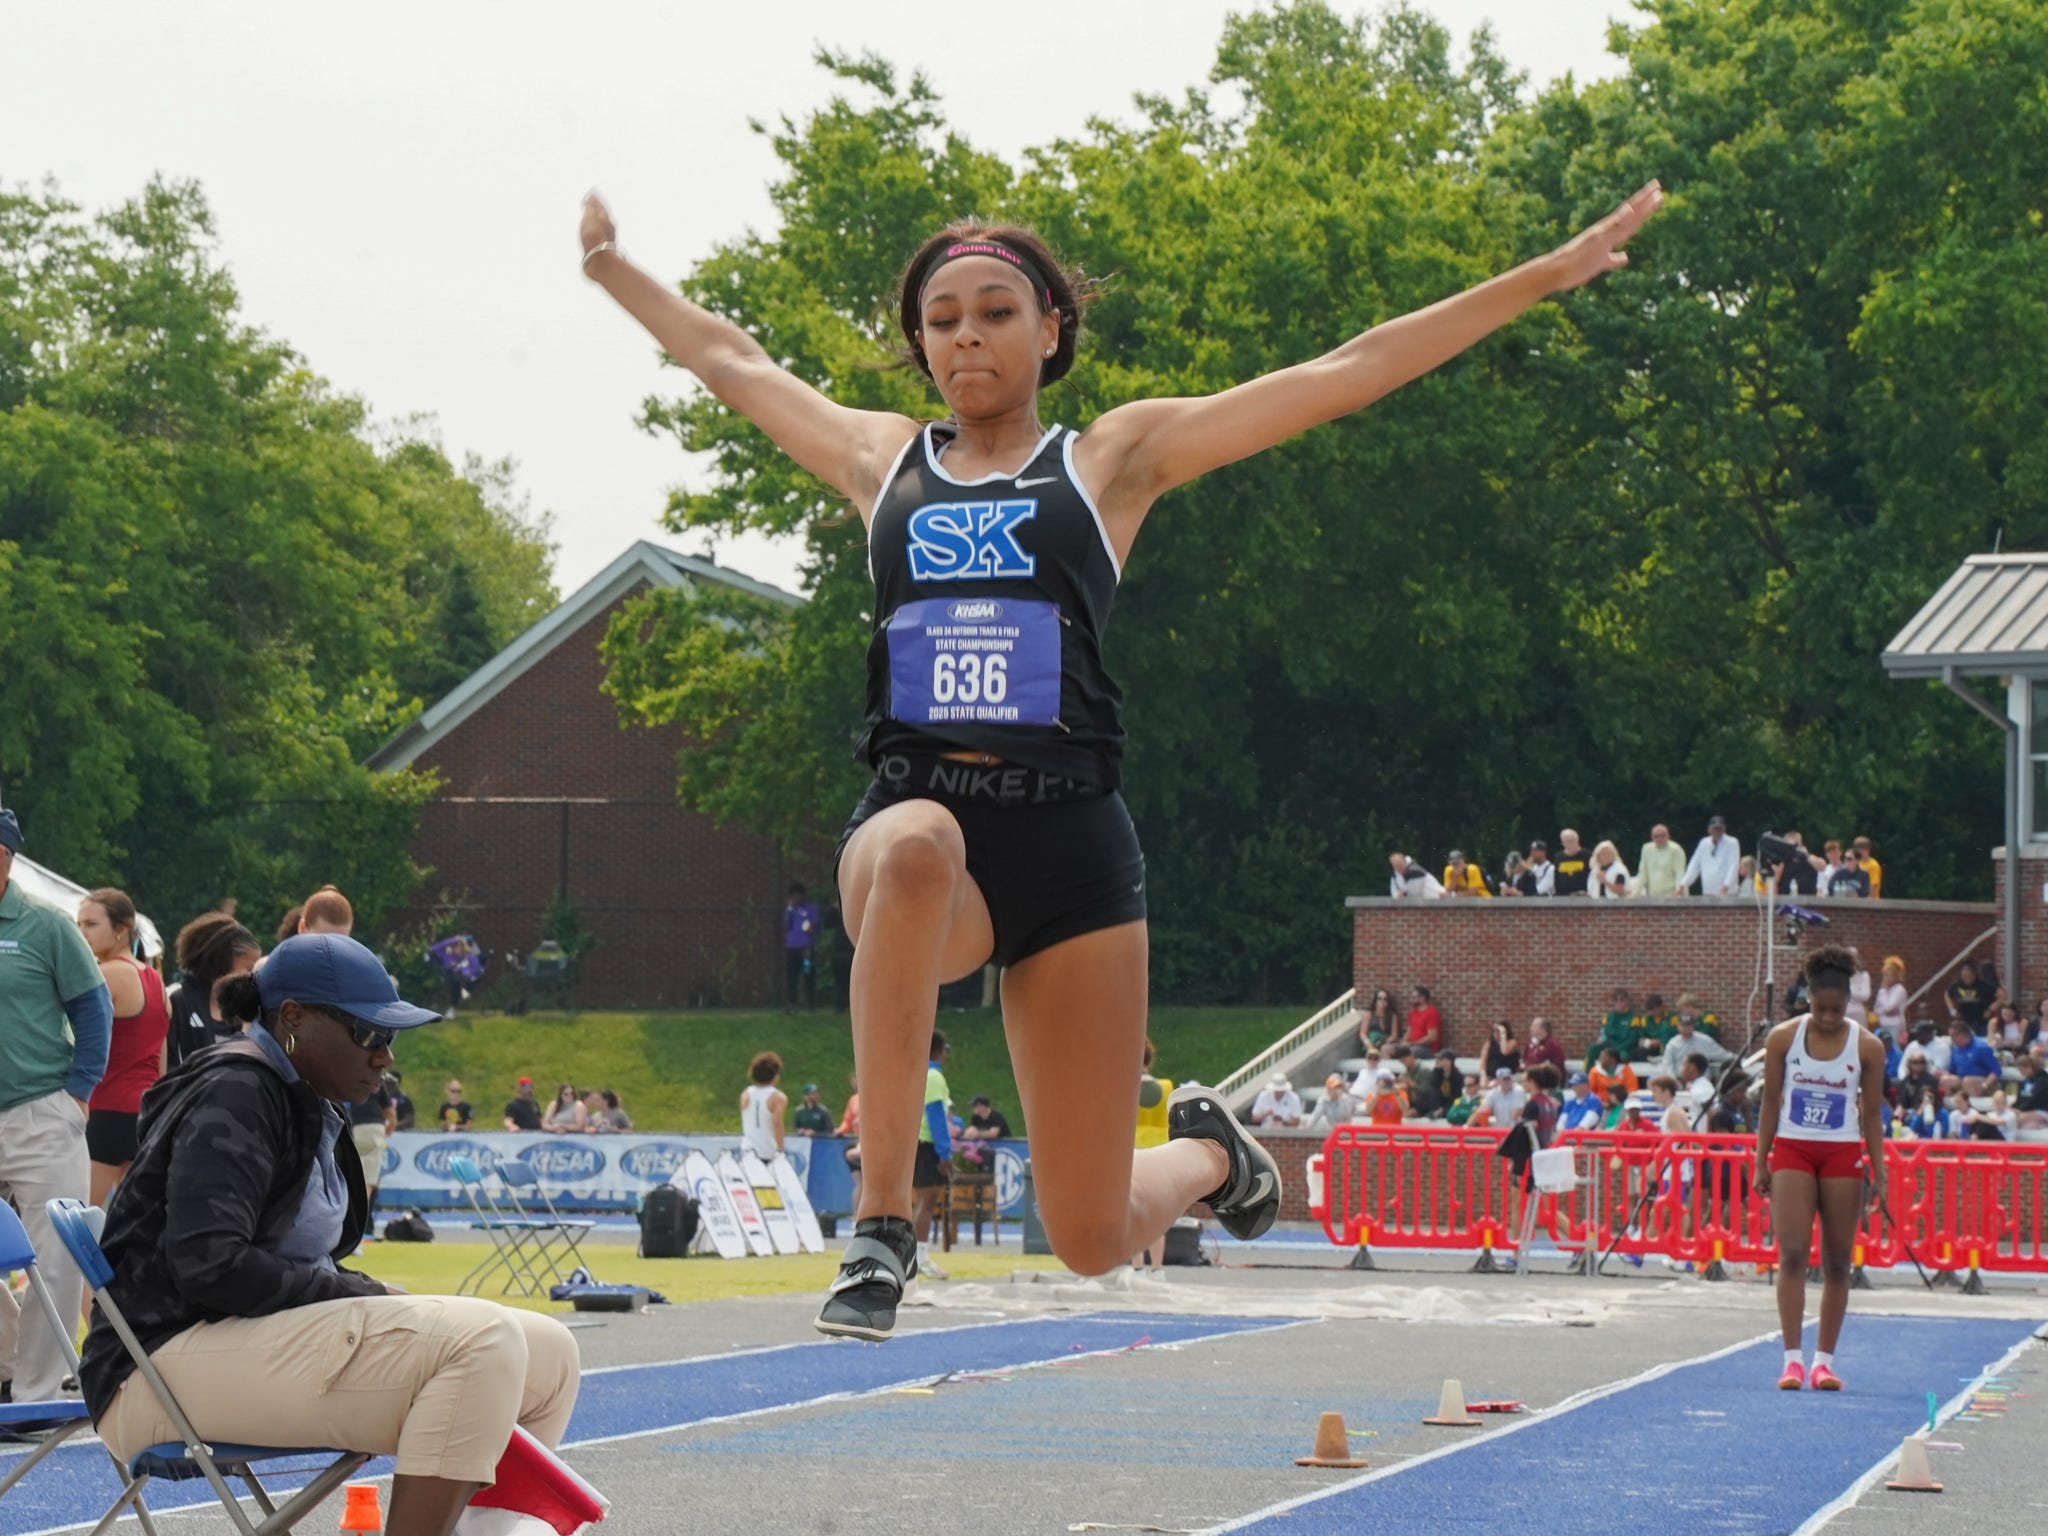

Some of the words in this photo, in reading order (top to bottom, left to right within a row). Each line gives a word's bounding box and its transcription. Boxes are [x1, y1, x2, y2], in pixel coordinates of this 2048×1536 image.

[907, 498, 1038, 583] SK
[979, 626, 997, 637] TRACK
[1003, 626, 1020, 638] FIELD
[935, 639, 956, 652] STATE
[957, 639, 1013, 653] CHAMPIONSHIPS
[933, 653, 1007, 704] 636
[950, 706, 975, 720] STATE
[976, 706, 1019, 721] QUALIFIER
[928, 764, 1029, 799] NIKE
[1803, 1106, 1829, 1124] 327
[530, 1150, 594, 1173] KHSAA
